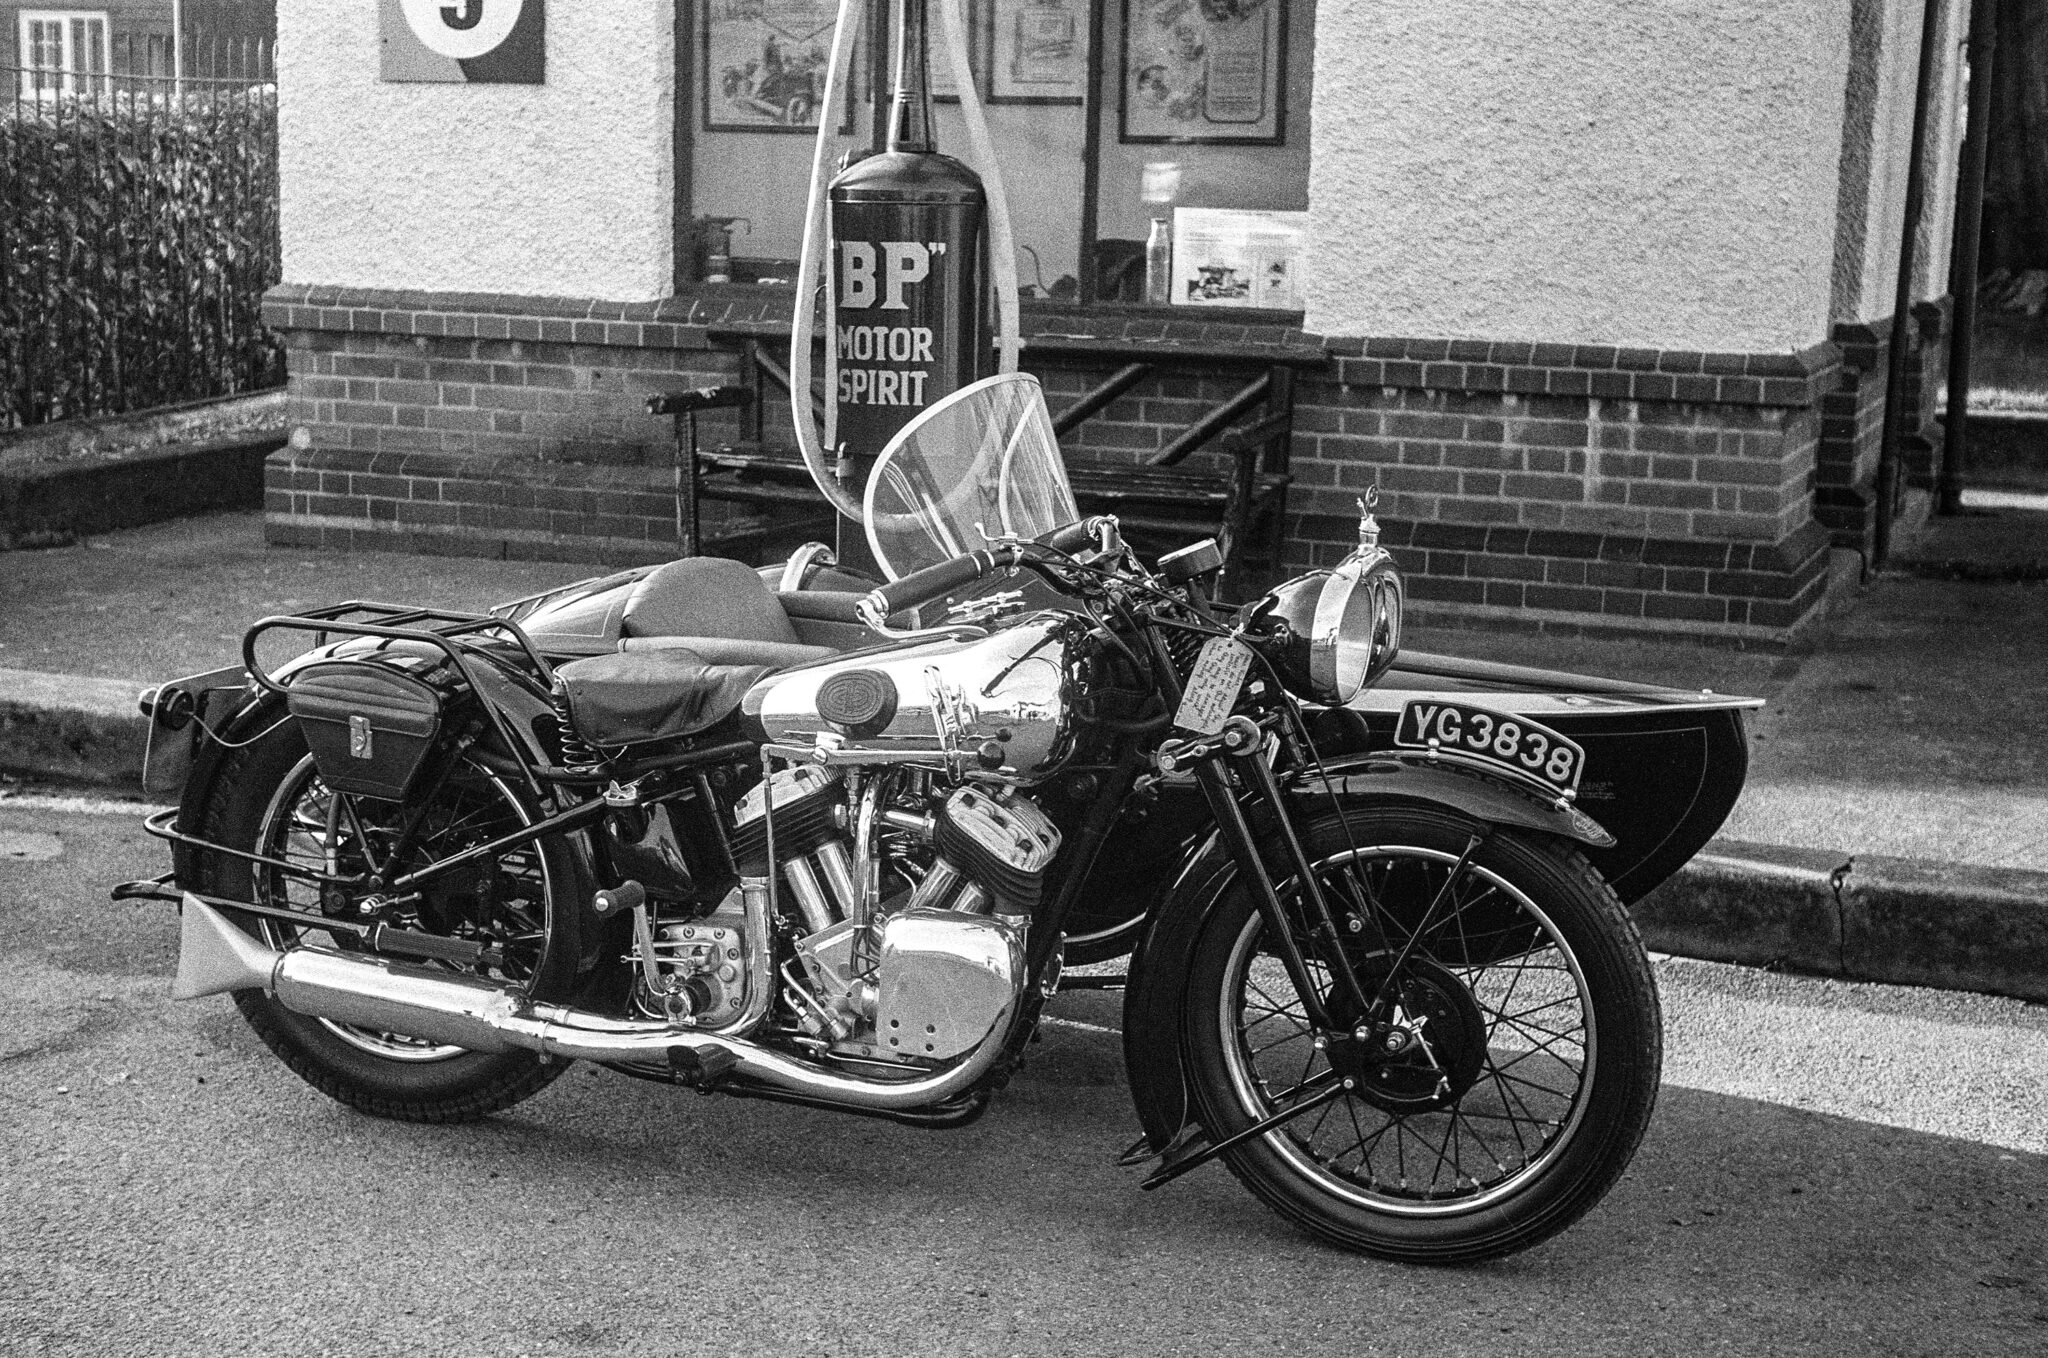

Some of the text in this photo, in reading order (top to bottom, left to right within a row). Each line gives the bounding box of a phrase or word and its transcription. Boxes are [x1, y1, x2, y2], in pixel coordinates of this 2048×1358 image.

[837, 325, 934, 361] MOTOR
[838, 369, 928, 406] SPIRIT
[1414, 705, 1573, 781] YG3838
